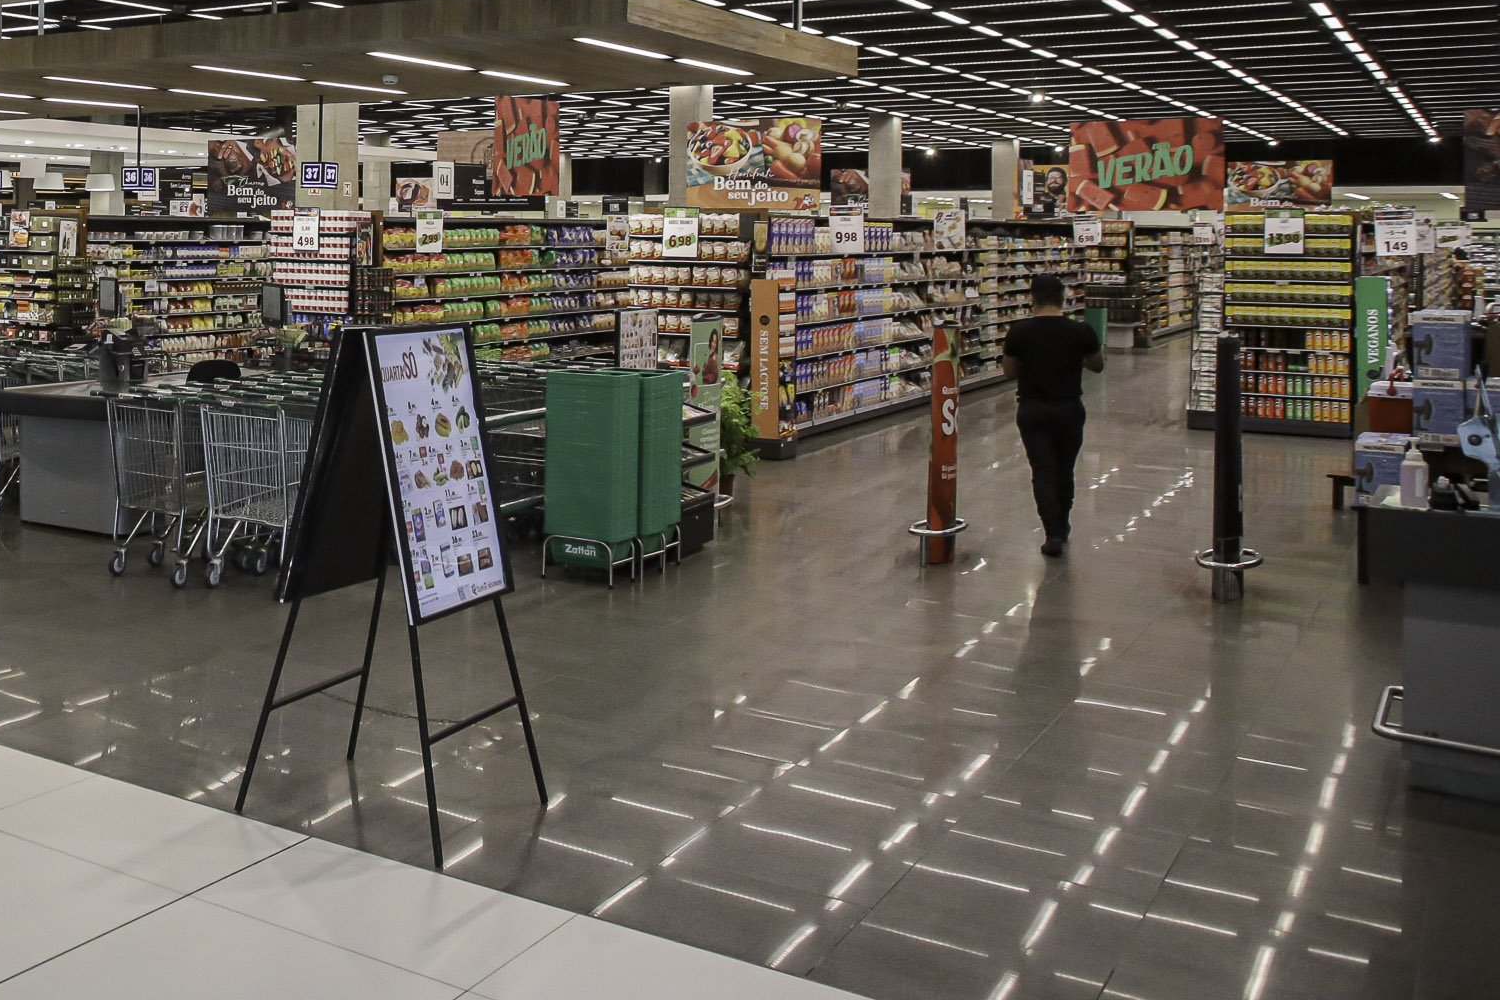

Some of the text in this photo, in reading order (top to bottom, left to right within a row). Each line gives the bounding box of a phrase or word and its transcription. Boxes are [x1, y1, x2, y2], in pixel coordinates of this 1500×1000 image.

[506, 123, 547, 170] VERÃO
[305, 167, 318, 179] 37
[1097, 142, 1194, 189] VERÃO
[125, 172, 136, 182] 36
[144, 173, 153, 182] 36
[326, 168, 335, 180] 37
[439, 174, 450, 186] 04
[227, 185, 253, 196] Bem
[713, 176, 768, 191] Bem do
[251, 194, 278, 209] jeito
[728, 188, 789, 206] seu jeito
[1250, 197, 1280, 207] Bem
[1366, 308, 1379, 364] VEGANOS
[381, 346, 418, 383] QUARTA SÓ
[760, 330, 769, 410] SEM LACTOSE
[941, 399, 959, 435] S
[565, 543, 596, 557] Zaffari
